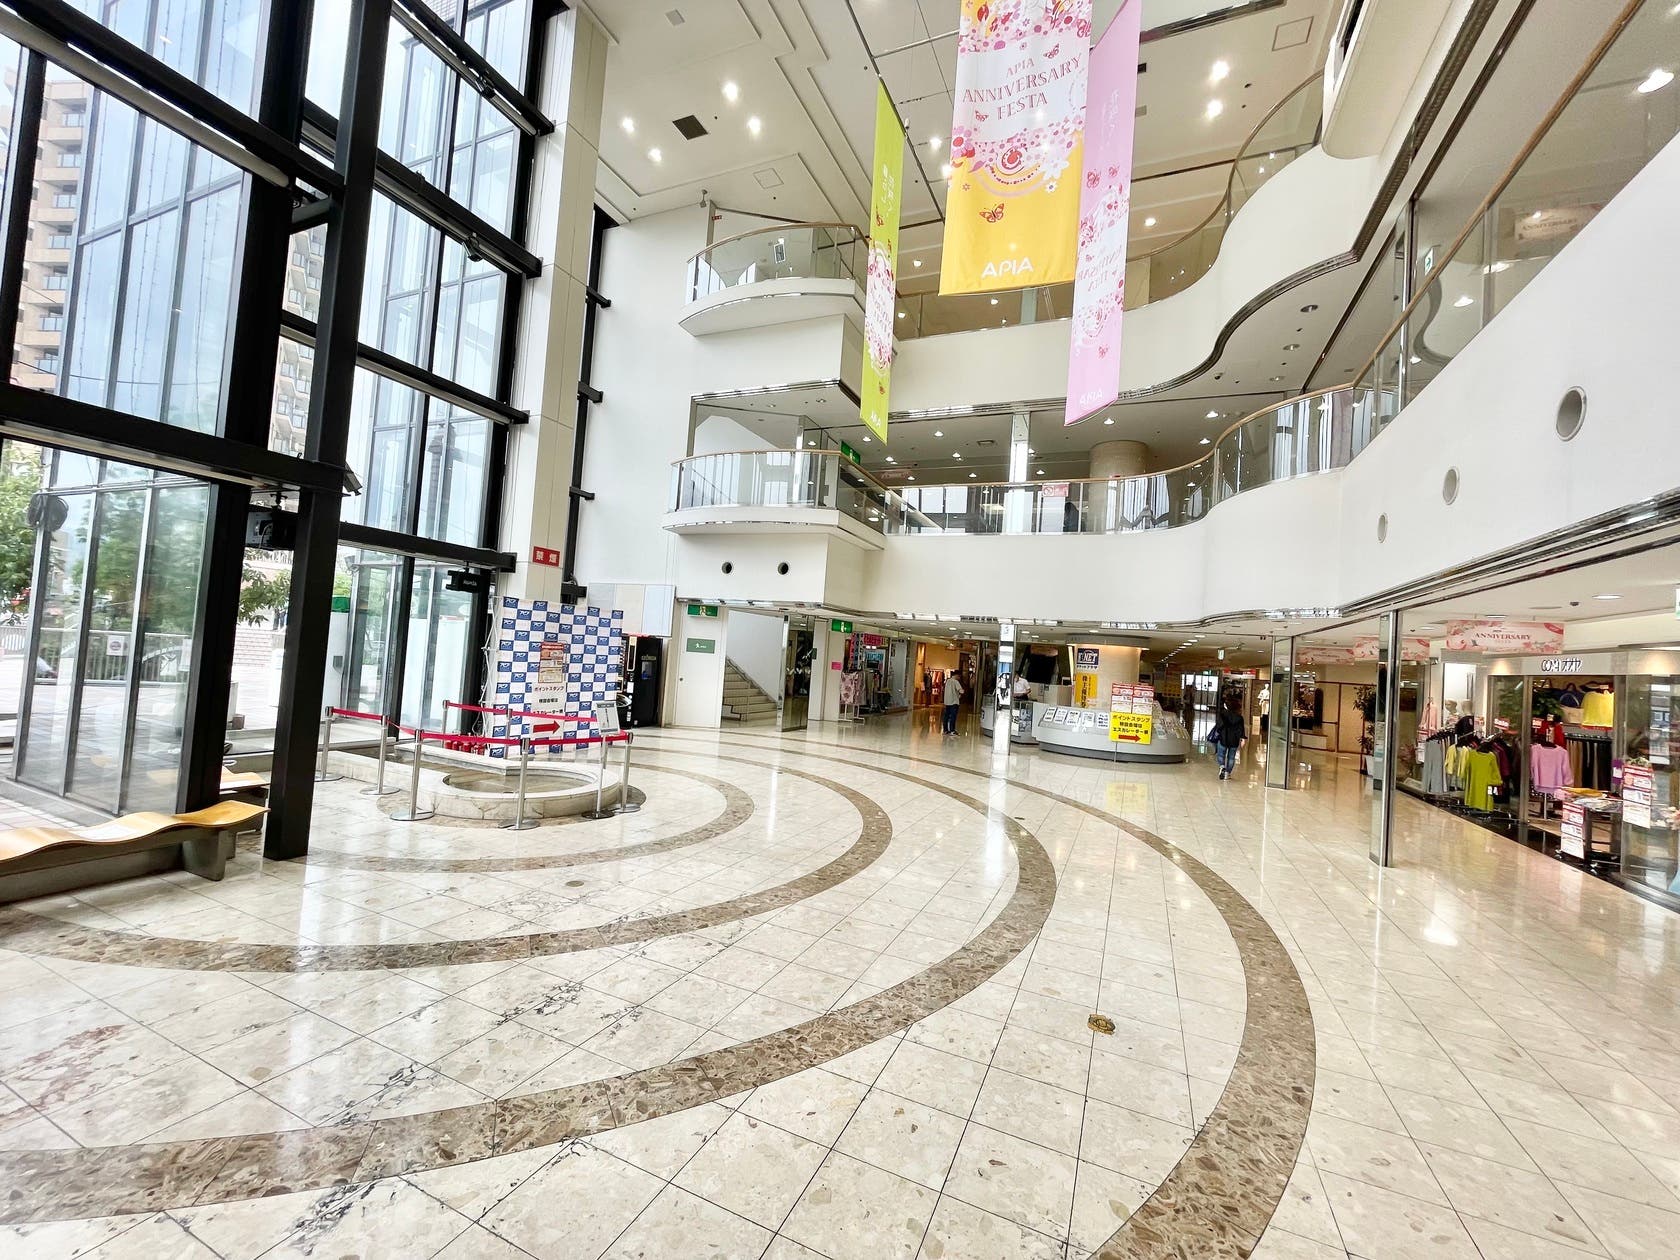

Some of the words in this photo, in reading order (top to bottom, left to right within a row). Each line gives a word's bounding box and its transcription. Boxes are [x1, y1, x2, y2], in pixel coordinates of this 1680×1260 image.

[962, 52, 1082, 103] ANNIVERSARY
[1006, 57, 1034, 77] APIA
[997, 92, 1048, 120] FESTA
[982, 257, 1034, 279] APIA
[1475, 632, 1531, 641] ANNIVERSARY
